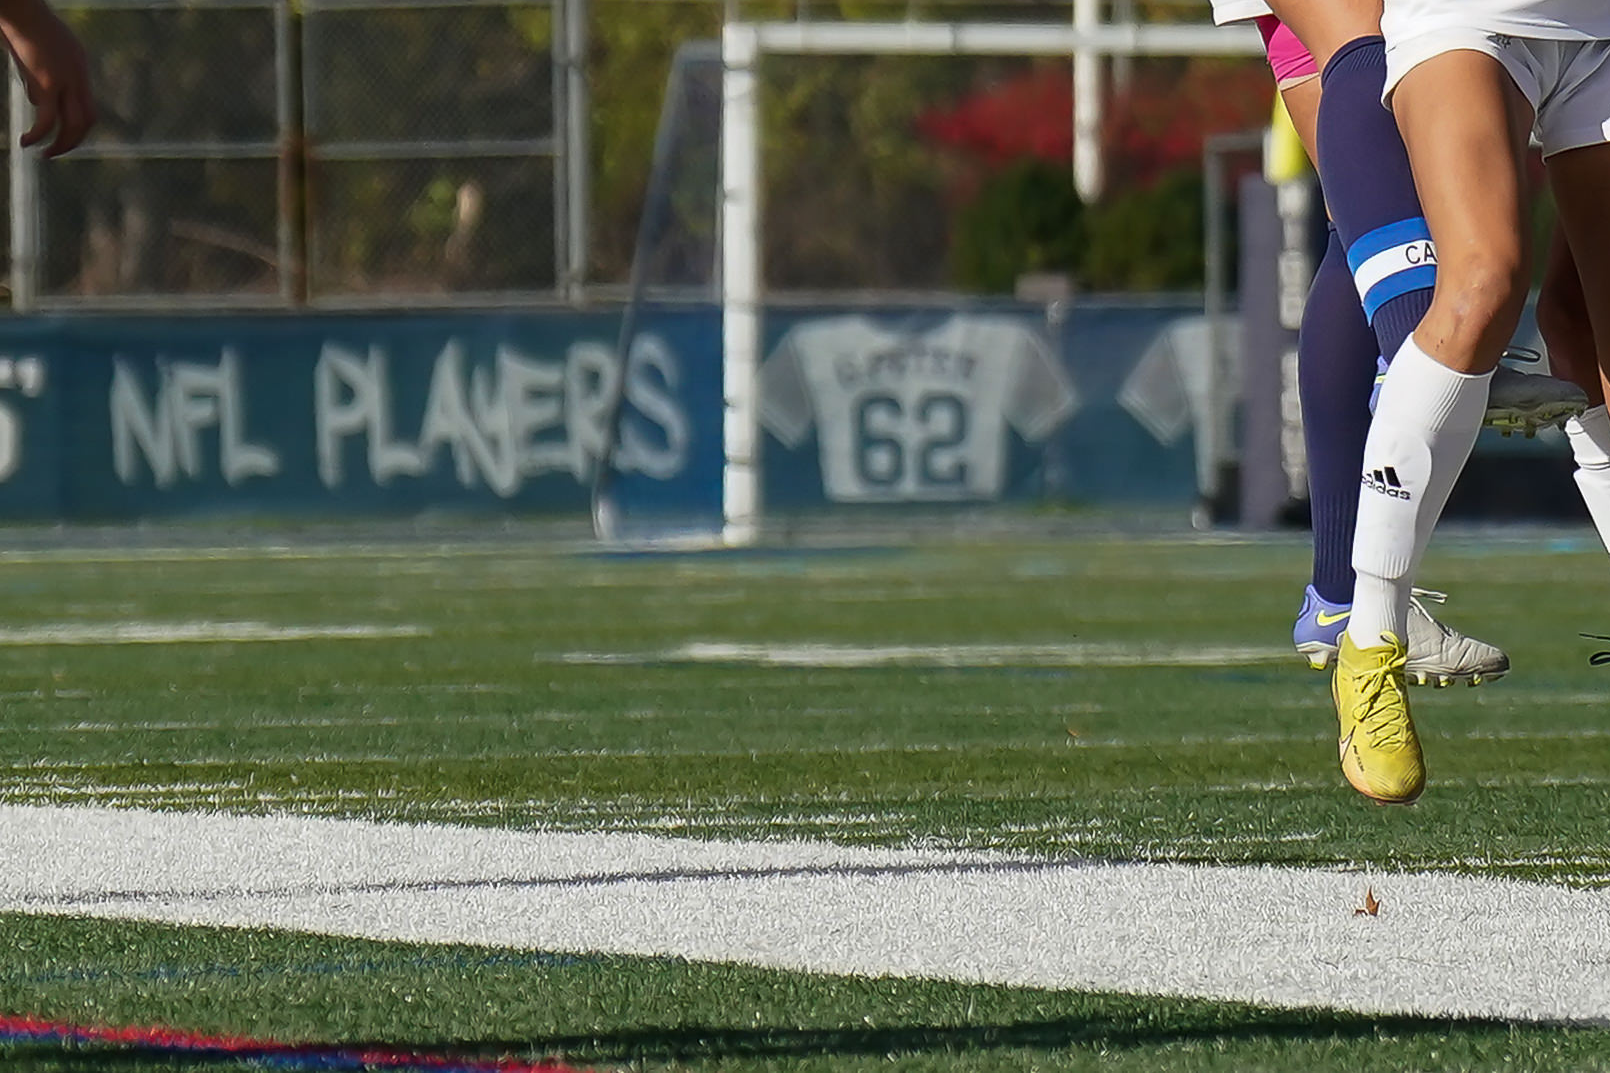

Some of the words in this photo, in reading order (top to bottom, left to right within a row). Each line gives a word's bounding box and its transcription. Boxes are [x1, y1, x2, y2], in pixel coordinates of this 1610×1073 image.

[110, 347, 280, 490] NFL
[312, 335, 690, 497] PLAYERS
[853, 389, 968, 487] 62
